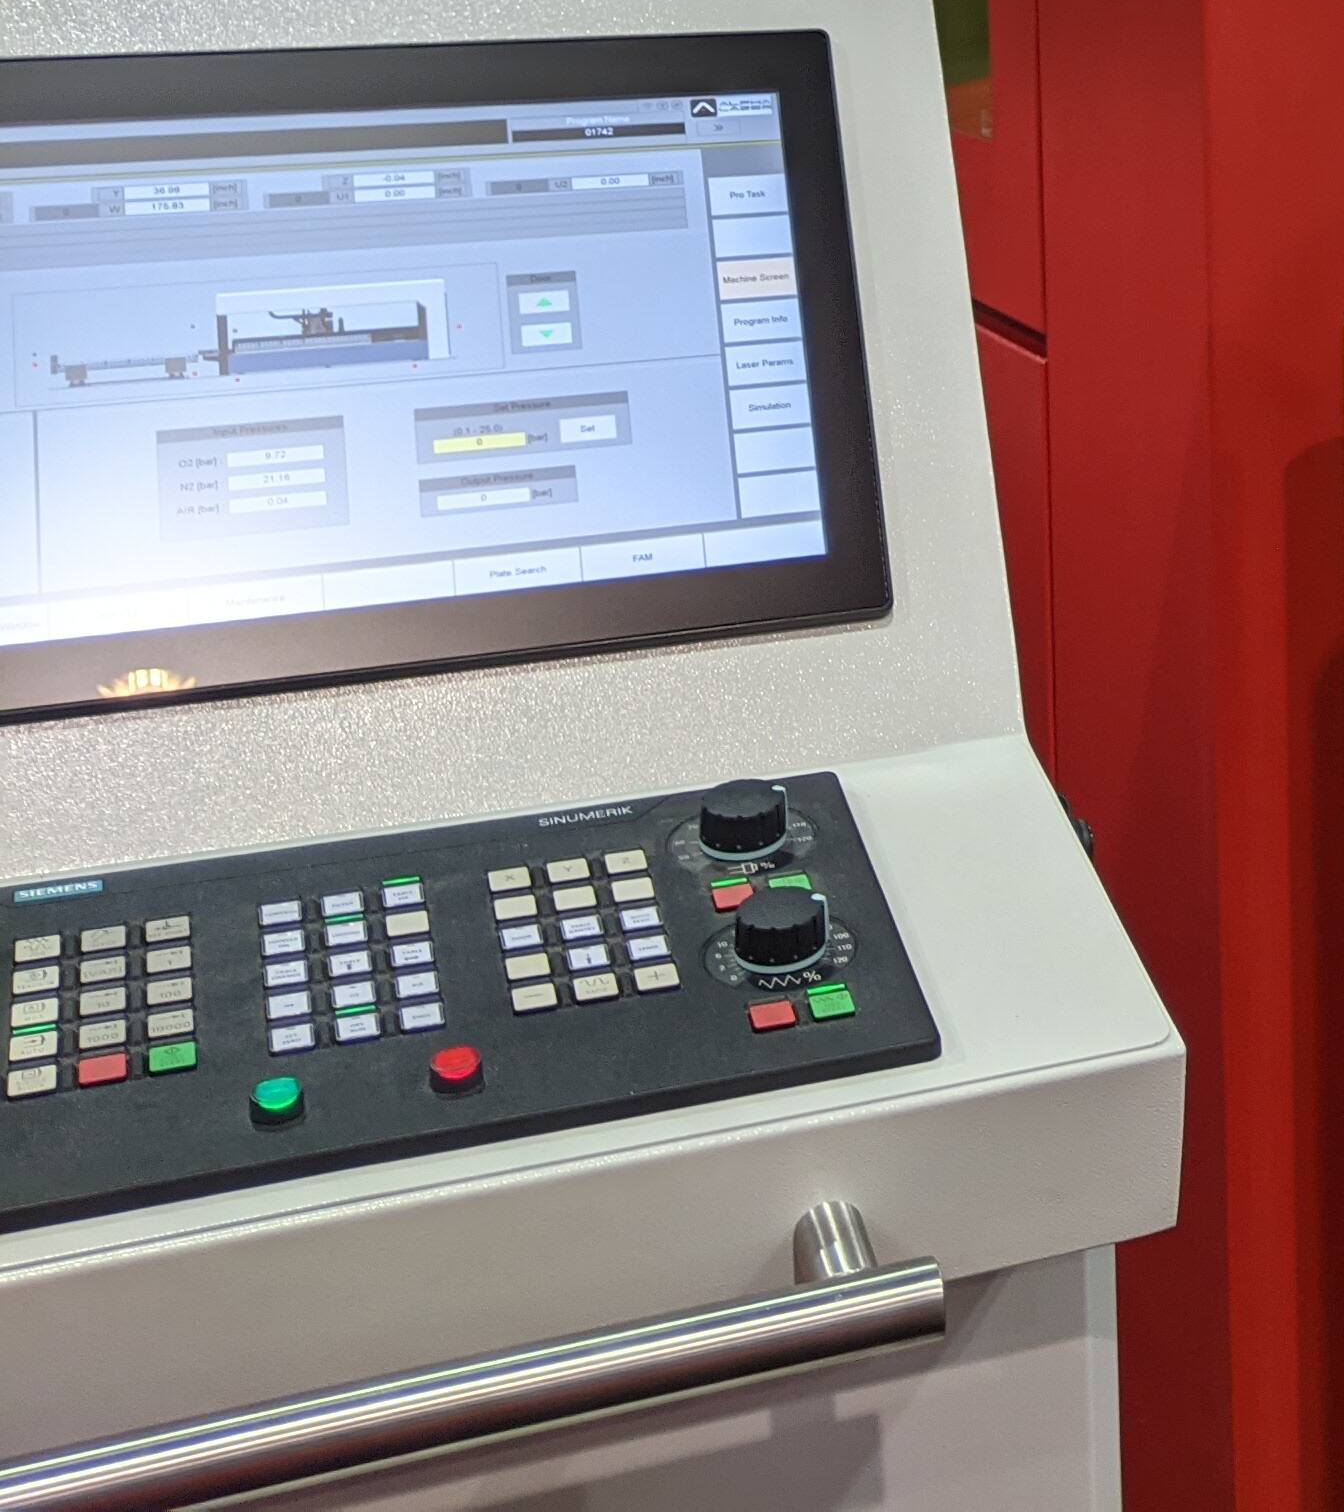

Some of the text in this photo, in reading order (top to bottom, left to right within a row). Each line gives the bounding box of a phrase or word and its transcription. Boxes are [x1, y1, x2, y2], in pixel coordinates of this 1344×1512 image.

[585, 127, 613, 137] 01742
[600, 177, 621, 186] 0.00
[730, 189, 766, 199] Pro Task
[723, 272, 789, 284] Machine Screen
[734, 315, 789, 328] Program Info
[736, 358, 794, 370] Laser Params
[748, 401, 792, 413] Simulation
[580, 424, 596, 434] Set
[632, 552, 653, 563] FAM
[489, 565, 547, 579] Plate Search
[538, 805, 633, 827] SINUMERIK
[19, 881, 98, 899] SIEMENS
[836, 943, 852, 951] 110
[832, 956, 848, 965] 120
